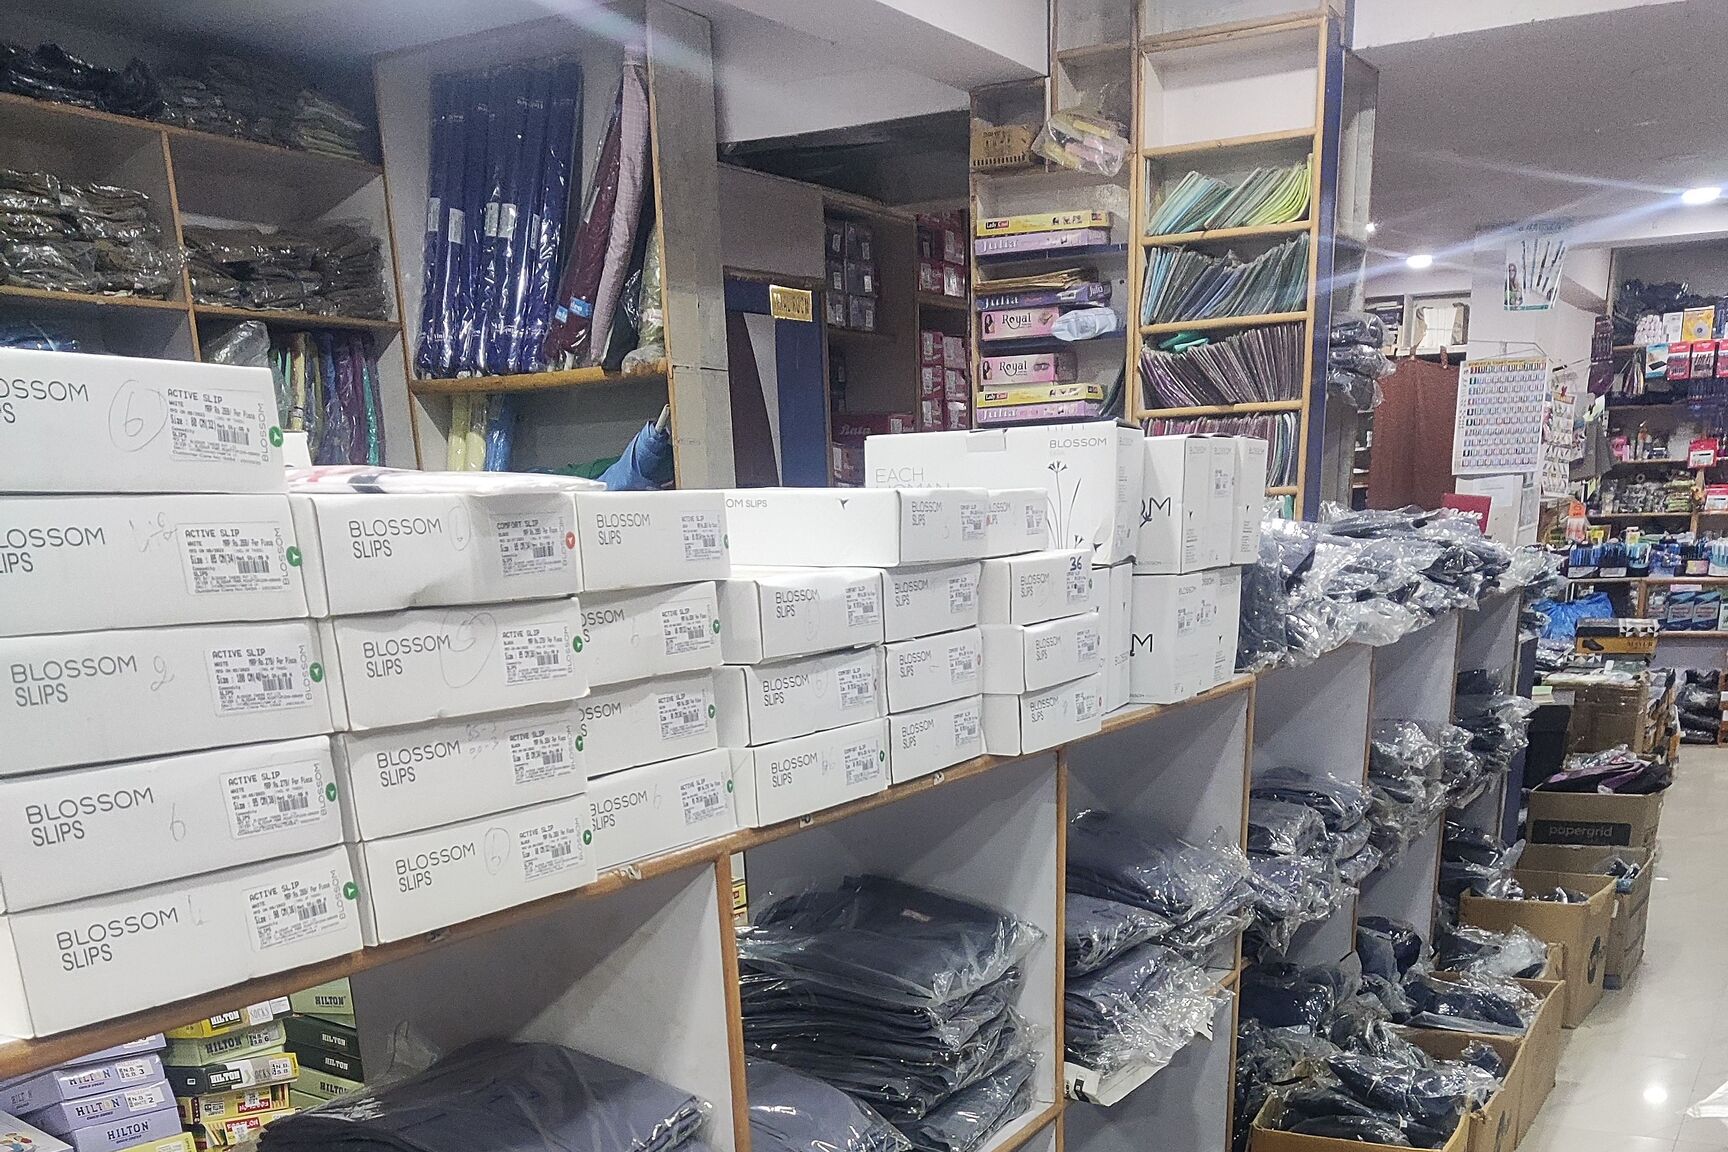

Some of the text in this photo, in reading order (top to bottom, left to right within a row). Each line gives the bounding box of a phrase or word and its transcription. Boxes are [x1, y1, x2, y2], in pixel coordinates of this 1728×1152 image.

[984, 296, 1019, 309] Julia
[1002, 313, 1032, 329] Royal
[1000, 361, 1027, 376] Royal
[168, 388, 223, 404] ACTIVE SLIP
[983, 408, 1017, 421] Julia
[258, 403, 269, 462] BLOSSOM
[1049, 437, 1107, 449] BLOSSOM
[875, 467, 924, 483] EACH
[745, 499, 767, 508] SLIPS
[911, 501, 942, 513] BLOSSOM
[349, 518, 442, 538] BLOSSOM
[596, 513, 650, 529] BLOSSOM
[912, 514, 926, 526] SLIPS
[0, 527, 105, 550] OSSOM
[185, 529, 240, 538] ACTIVE SLIP
[598, 530, 622, 545] SLIPS
[274, 528, 290, 586] BLOSSOM
[352, 540, 393, 559] SLIPS
[0, 551, 34, 573] IPS
[1069, 556, 1082, 570] 36
[895, 579, 929, 594] BLOSSOM
[1020, 573, 1049, 586] BLOSSOM
[776, 589, 818, 604] BLOSSOM
[1021, 586, 1034, 597] SLIPS
[895, 594, 910, 607] SLIPS
[776, 604, 795, 618] SLIPS
[363, 634, 451, 659] BLOSSOM
[1036, 636, 1061, 650] BLOSSOM
[212, 648, 266, 659] ACTIVE SLIP
[900, 650, 932, 665] BLOSSOM
[1036, 650, 1048, 661] SLIPS
[11, 655, 138, 683] BLOSSOM
[299, 644, 312, 700] BLOSSOM
[366, 659, 403, 678] SLIPS
[900, 665, 914, 678] SLIPS
[763, 674, 809, 692] BLOSSOM
[14, 683, 69, 707] SLIPS
[764, 692, 784, 706] SLIPS
[1030, 696, 1059, 712] BLOSSOM
[1031, 711, 1044, 723] SLIPS
[901, 719, 935, 738] BLOSSOM
[509, 733, 529, 741] ACTIVE
[903, 736, 916, 749] SLIPS
[376, 740, 461, 769] BLOSSOM
[771, 753, 818, 775] BLOSSOM
[228, 771, 281, 786] ACTIVE SLIP
[380, 767, 416, 787] SLIPS
[772, 772, 793, 788] SLIPS
[314, 763, 327, 816] BLOSSOM
[25, 787, 155, 825] BLOSSOM
[169, 803, 186, 842] 6
[31, 820, 85, 847] SLIPS
[519, 828, 538, 838] ACTIVE
[1548, 826, 1613, 839] papergrid
[395, 843, 476, 875] BLOSSOM
[399, 871, 433, 894] SLIPS
[249, 880, 300, 902] ACTIVE SLIP
[56, 906, 179, 951] BLOSSOM
[61, 943, 113, 972] SLIPS
[315, 996, 344, 1006] HILTON
[210, 1011, 240, 1025] HILTON
[206, 1036, 242, 1054] HILTON
[322, 1033, 346, 1047] HILTON
[325, 1057, 348, 1071] HILTON
[210, 1071, 240, 1084] HILTON
[75, 1098, 120, 1117] HILTON
[107, 1122, 149, 1140] HILTON
